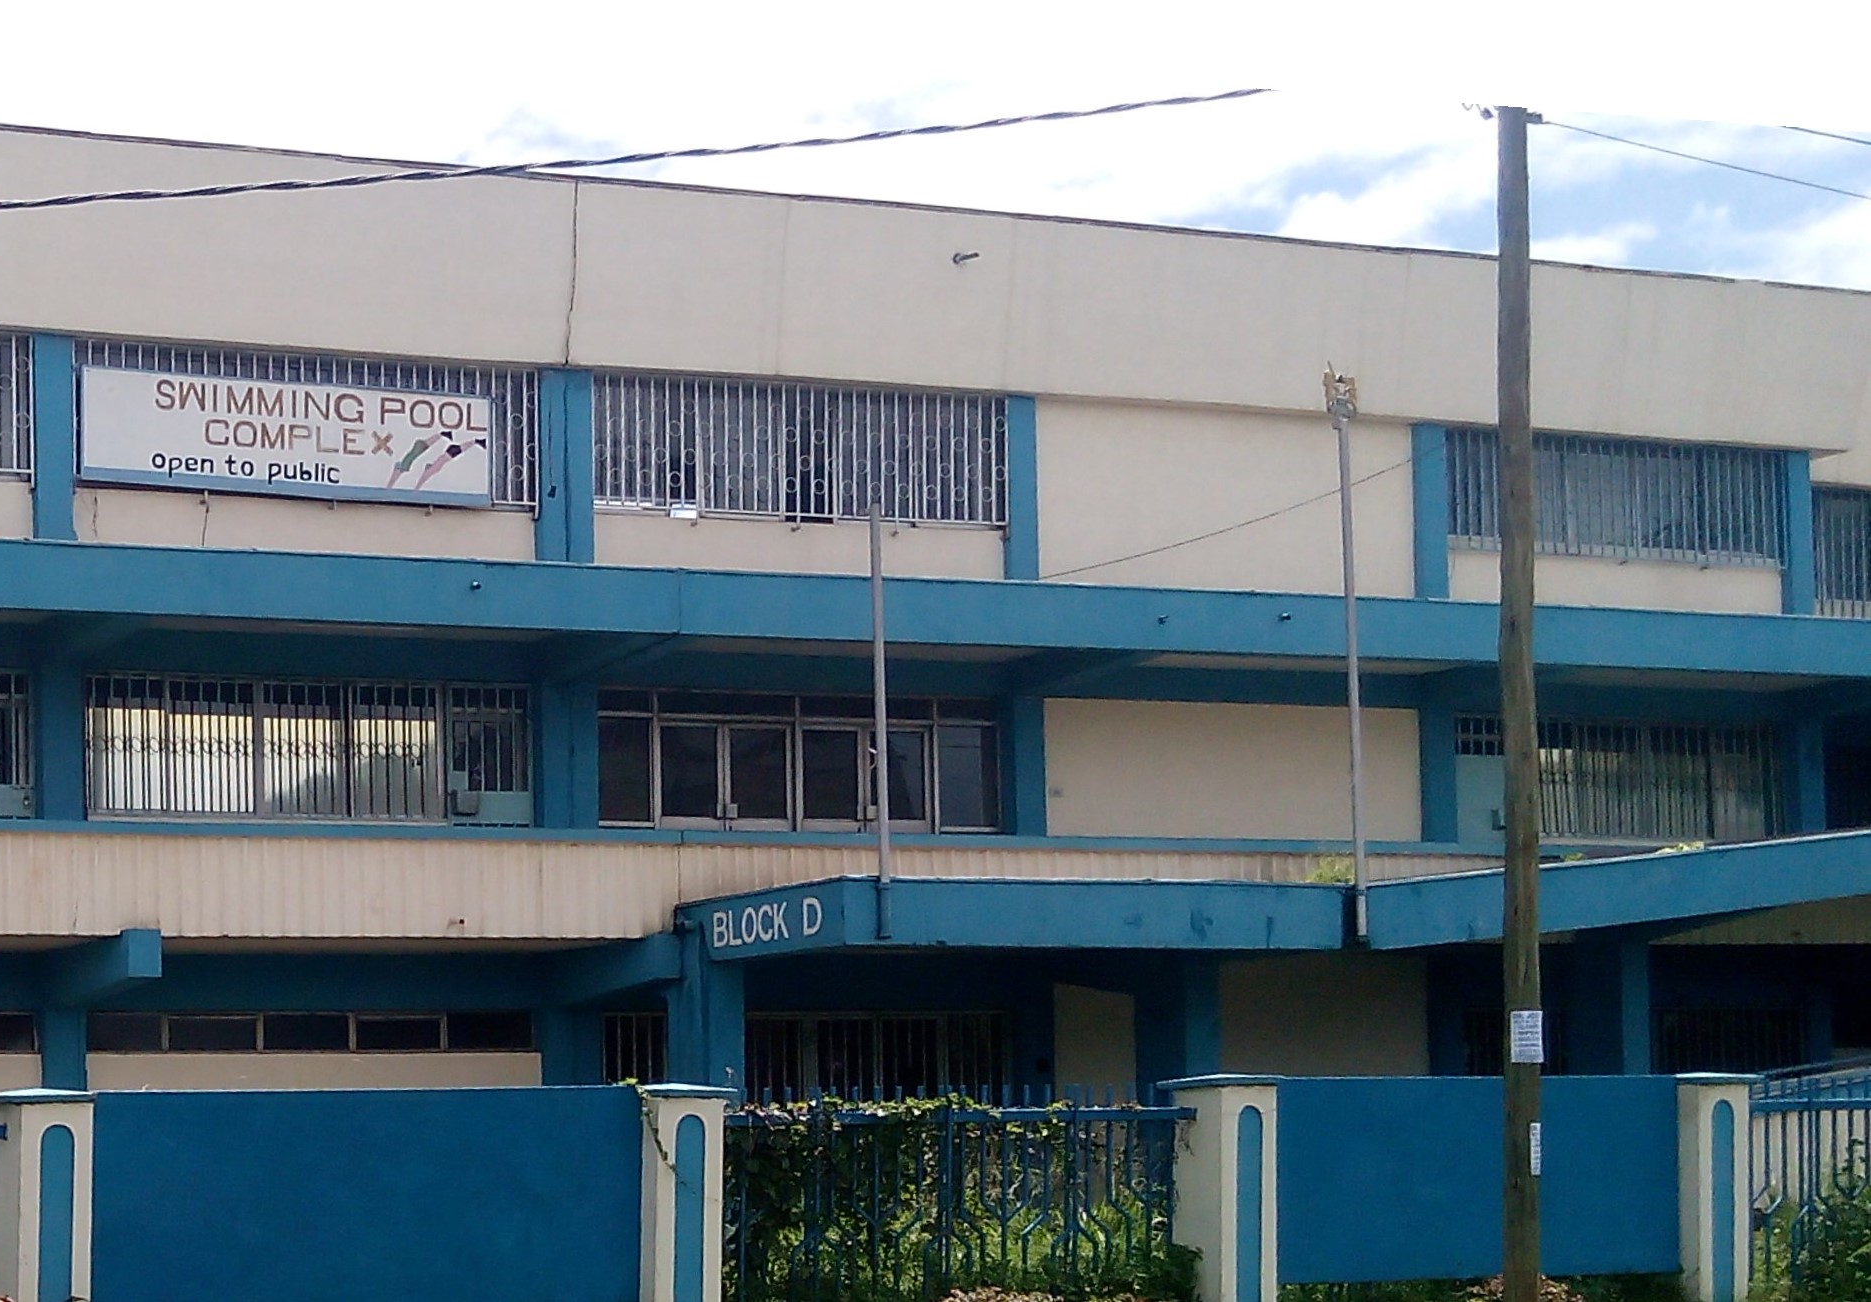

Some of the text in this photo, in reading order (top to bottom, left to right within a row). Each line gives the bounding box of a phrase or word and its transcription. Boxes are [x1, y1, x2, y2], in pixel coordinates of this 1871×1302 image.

[155, 379, 487, 432] SWIMMING POOL
[204, 419, 394, 456] COMPLEX
[151, 453, 340, 484] open to public
[713, 897, 822, 948] BLOCK D
